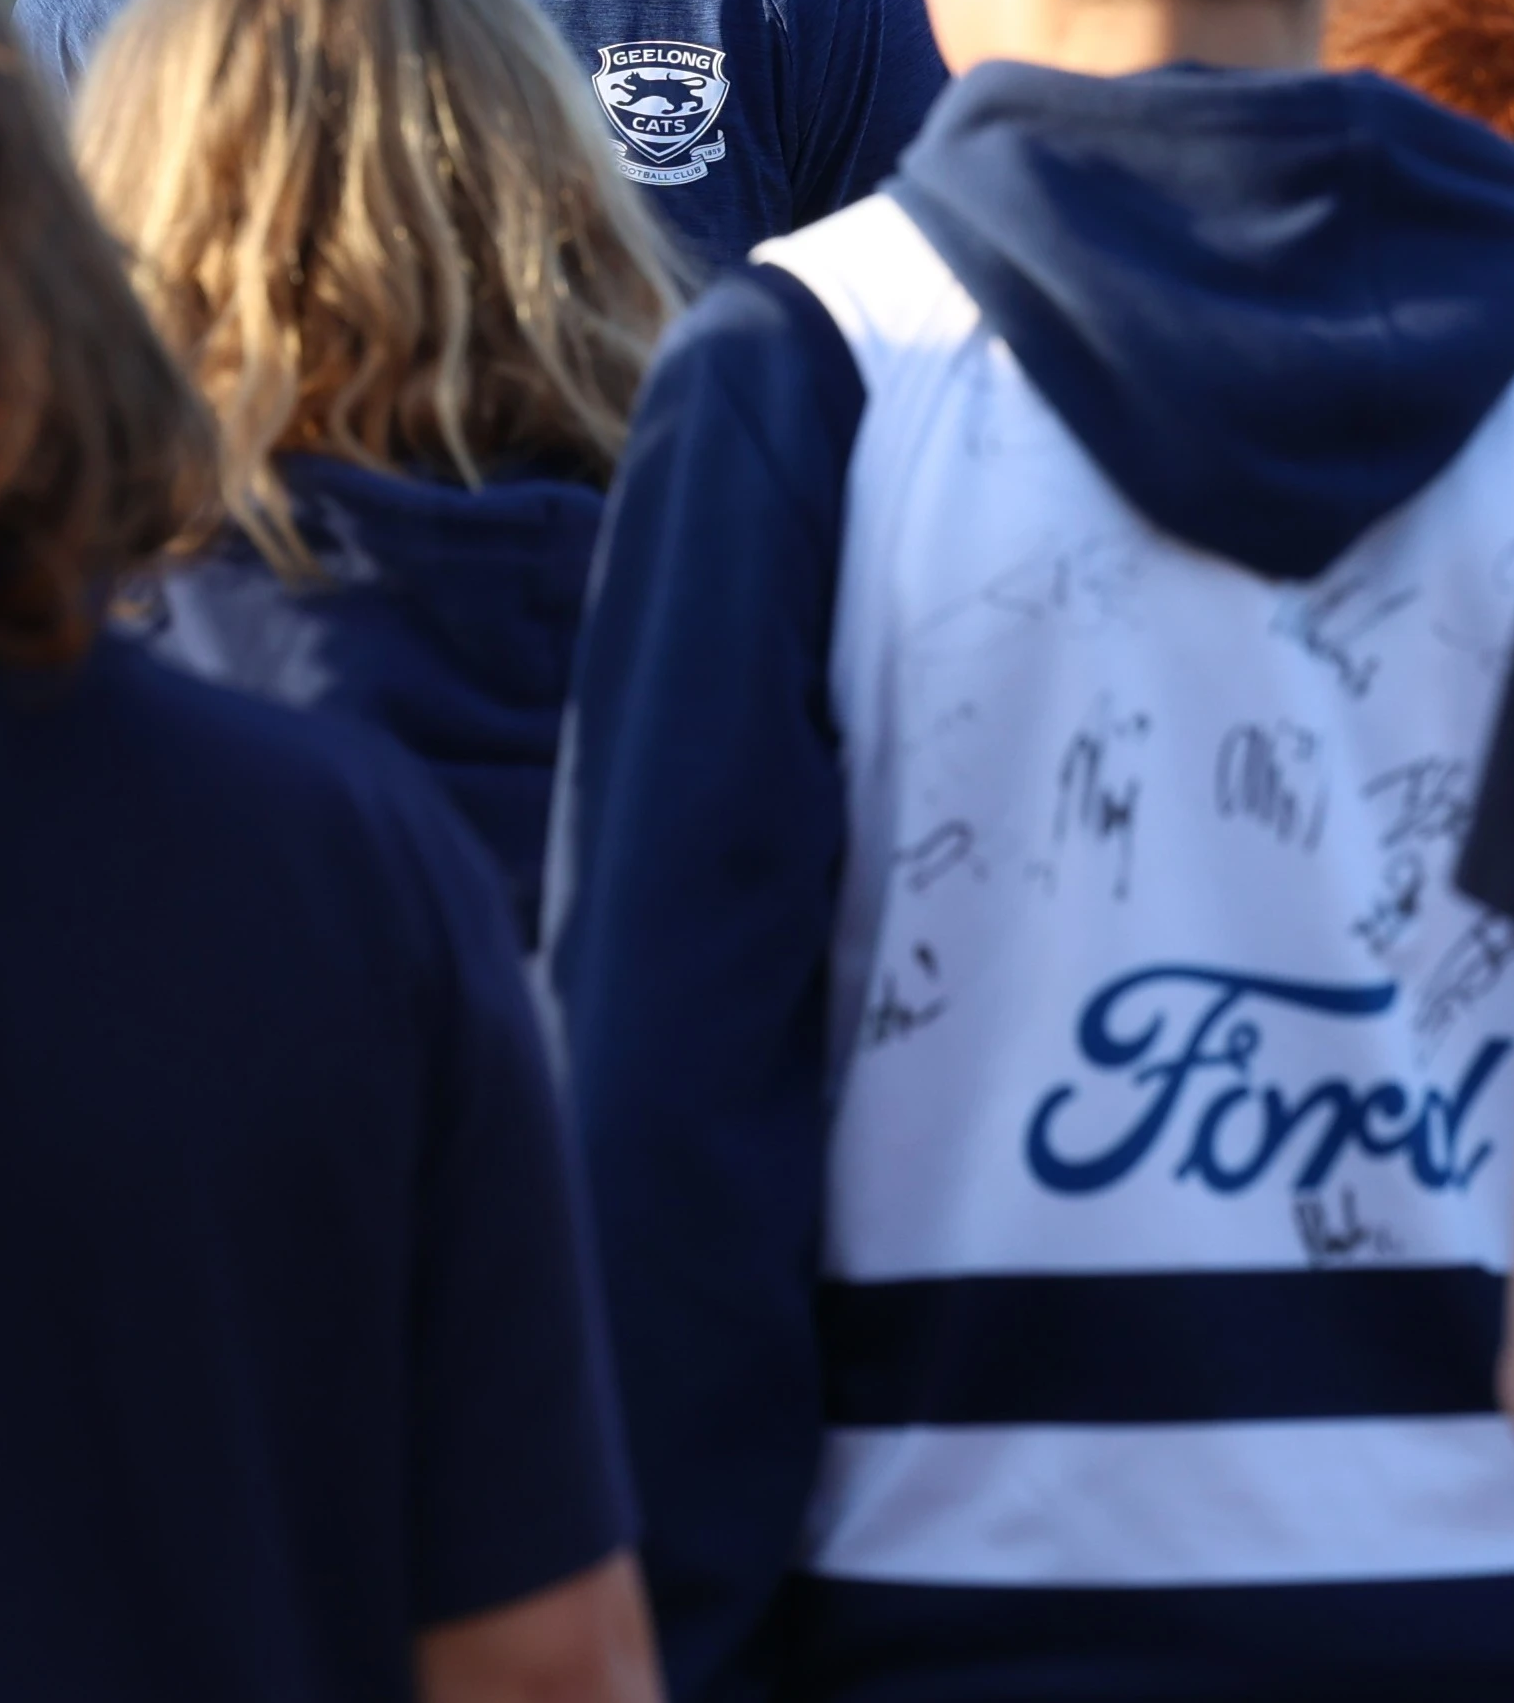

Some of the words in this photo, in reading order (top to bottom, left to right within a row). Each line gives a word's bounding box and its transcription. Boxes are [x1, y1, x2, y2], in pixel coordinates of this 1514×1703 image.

[612, 48, 711, 70] GEELONG
[632, 116, 686, 133] CATS
[673, 166, 702, 180] CLUB
